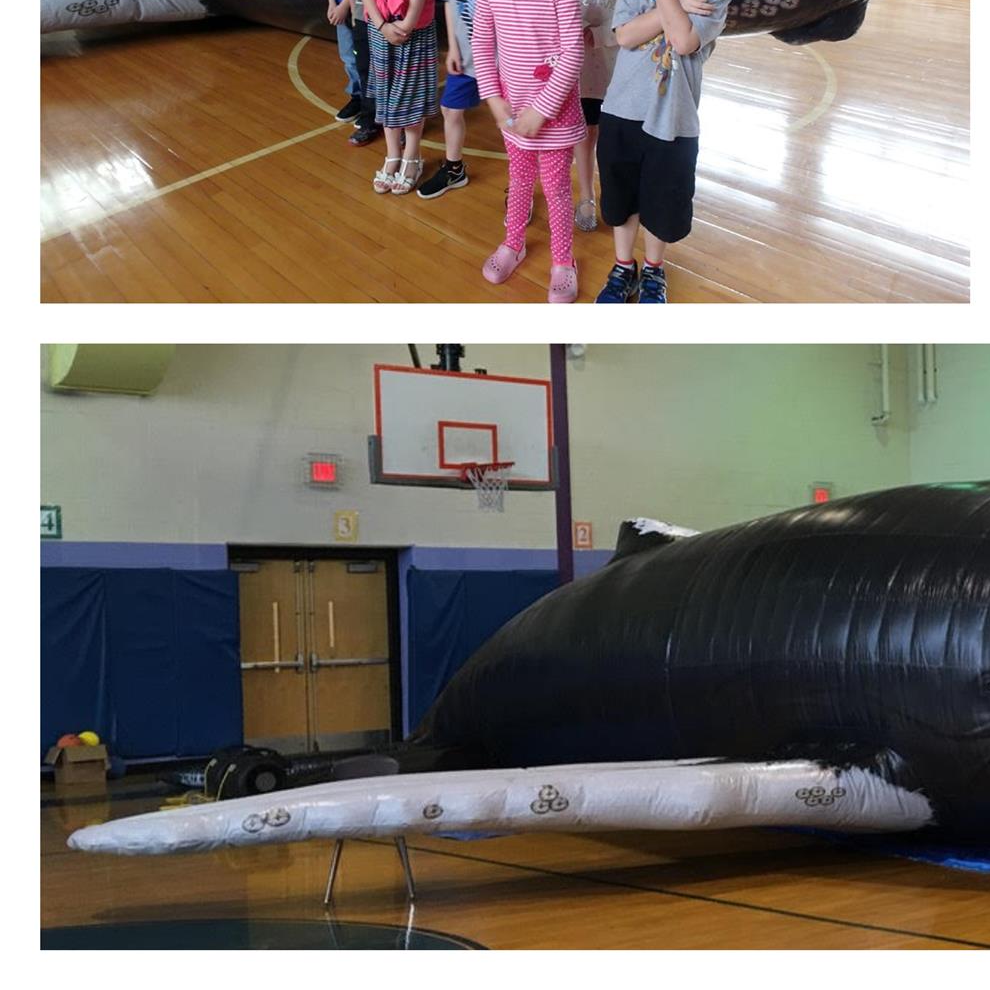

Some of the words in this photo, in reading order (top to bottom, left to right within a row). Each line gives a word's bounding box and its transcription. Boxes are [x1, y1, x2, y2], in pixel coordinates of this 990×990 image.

[40, 512, 54, 531] 4
[339, 517, 351, 535] 3
[579, 527, 587, 542] 2
